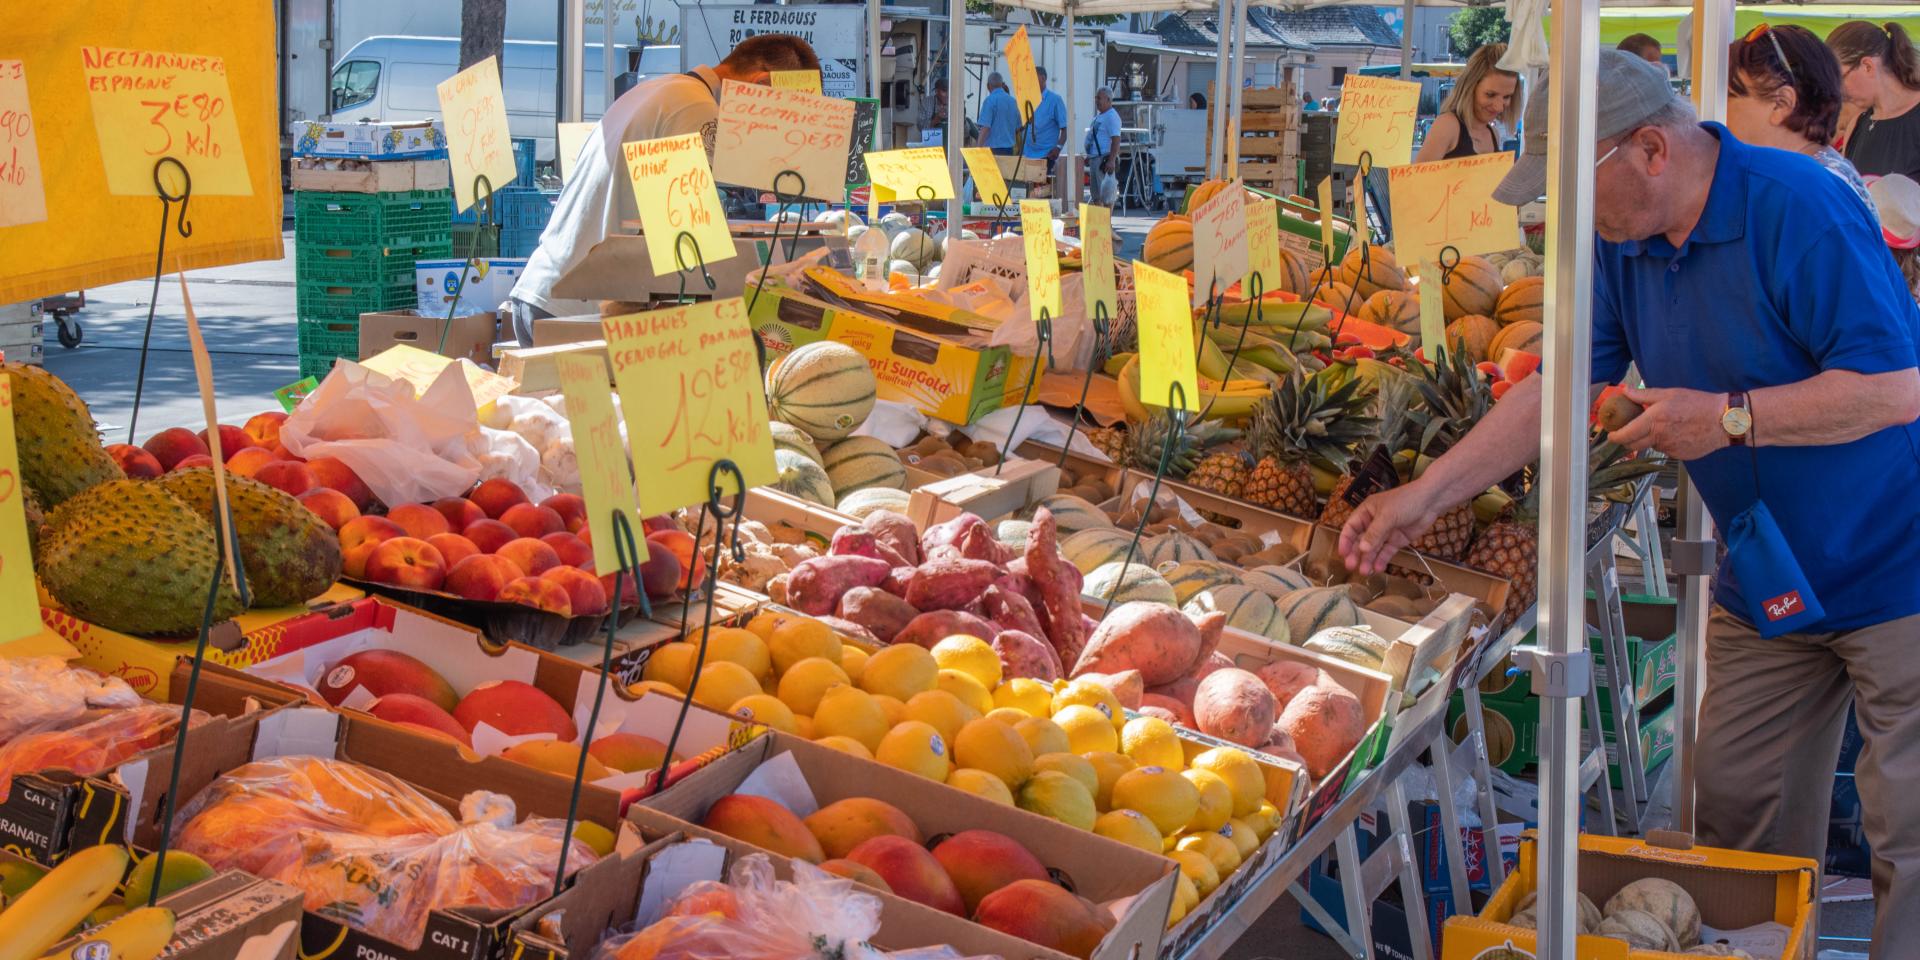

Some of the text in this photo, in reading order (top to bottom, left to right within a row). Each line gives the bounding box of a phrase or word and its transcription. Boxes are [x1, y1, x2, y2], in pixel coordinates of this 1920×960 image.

[734, 10, 745, 24] EL
[127, 674, 151, 688] VION
[431, 930, 460, 949] CAT
